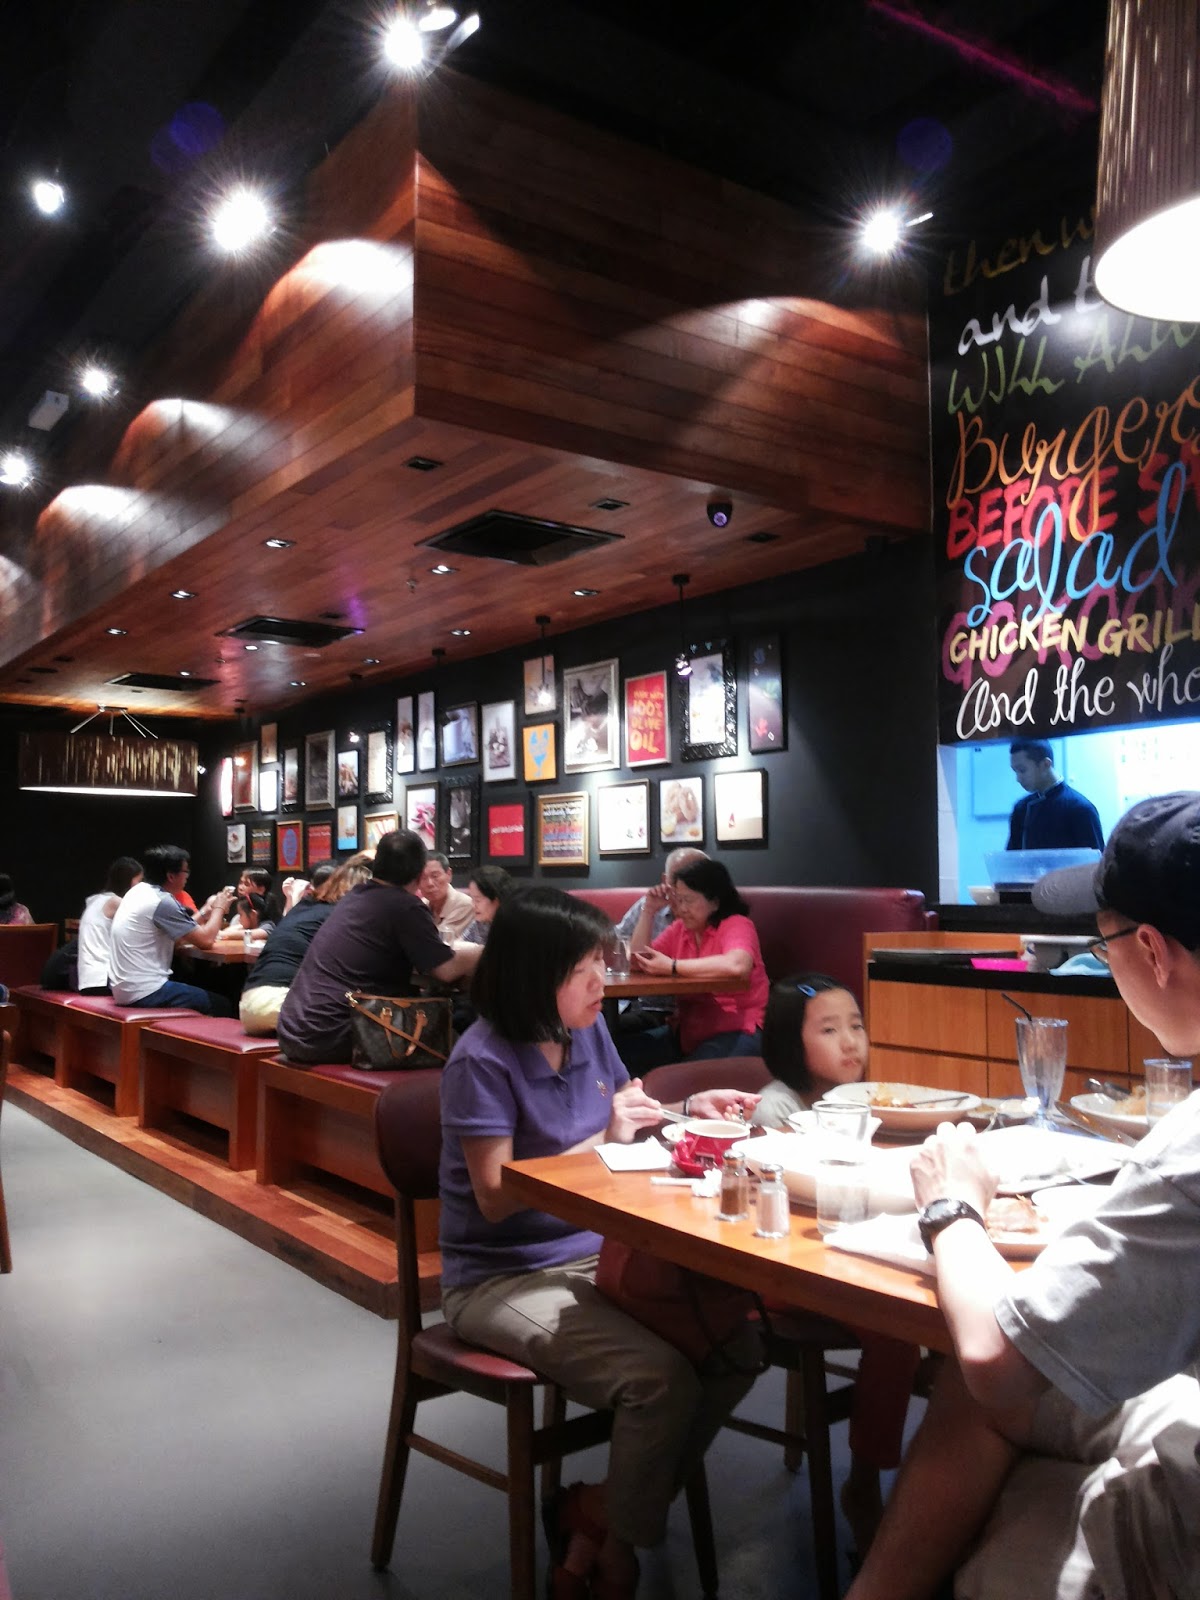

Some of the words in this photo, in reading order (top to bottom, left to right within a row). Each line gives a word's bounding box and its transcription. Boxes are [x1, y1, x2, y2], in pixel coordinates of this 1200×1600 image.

[957, 275, 1062, 356] and
[946, 465, 1119, 561] BEFORE
[963, 461, 1187, 628] salad
[949, 612, 1089, 665] CHICKEN
[1050, 657, 1116, 726] the
[629, 729, 661, 754] OIL
